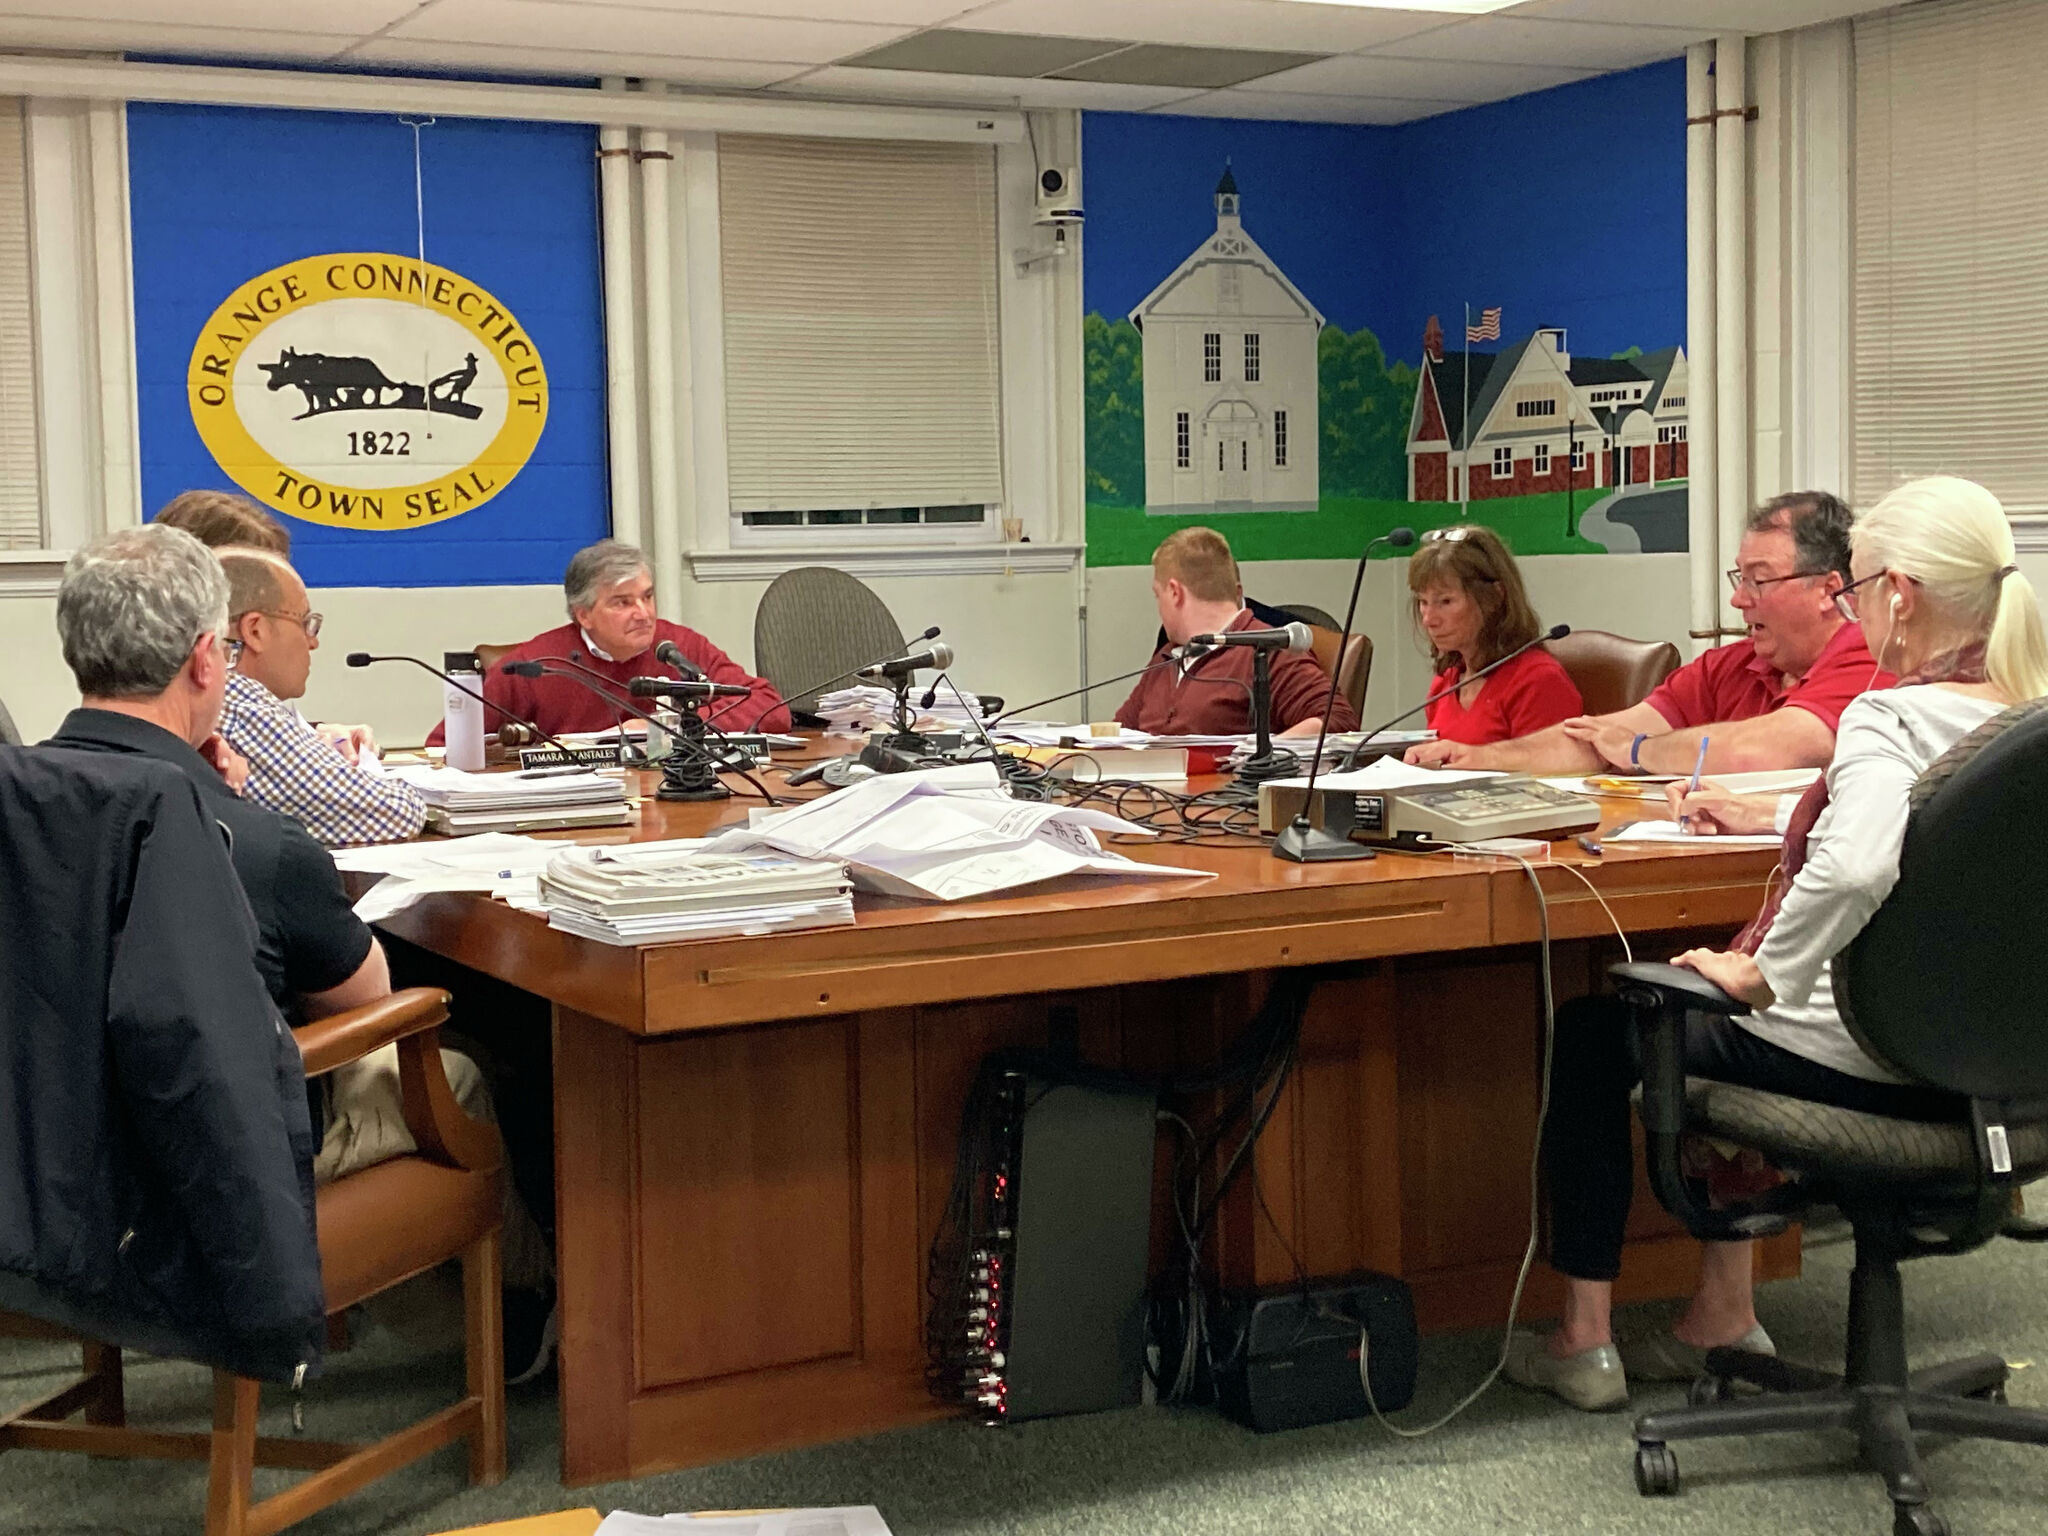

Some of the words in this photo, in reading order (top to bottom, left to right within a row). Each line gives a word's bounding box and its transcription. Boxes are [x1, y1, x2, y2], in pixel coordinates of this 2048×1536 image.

[199, 275, 307, 407] ORANGE
[326, 263, 541, 414] CONNECTICUT
[347, 431, 411, 456] 1822
[274, 471, 383, 520] TOWN
[405, 470, 495, 519] SEAL
[526, 752, 564, 763] TAMARA
